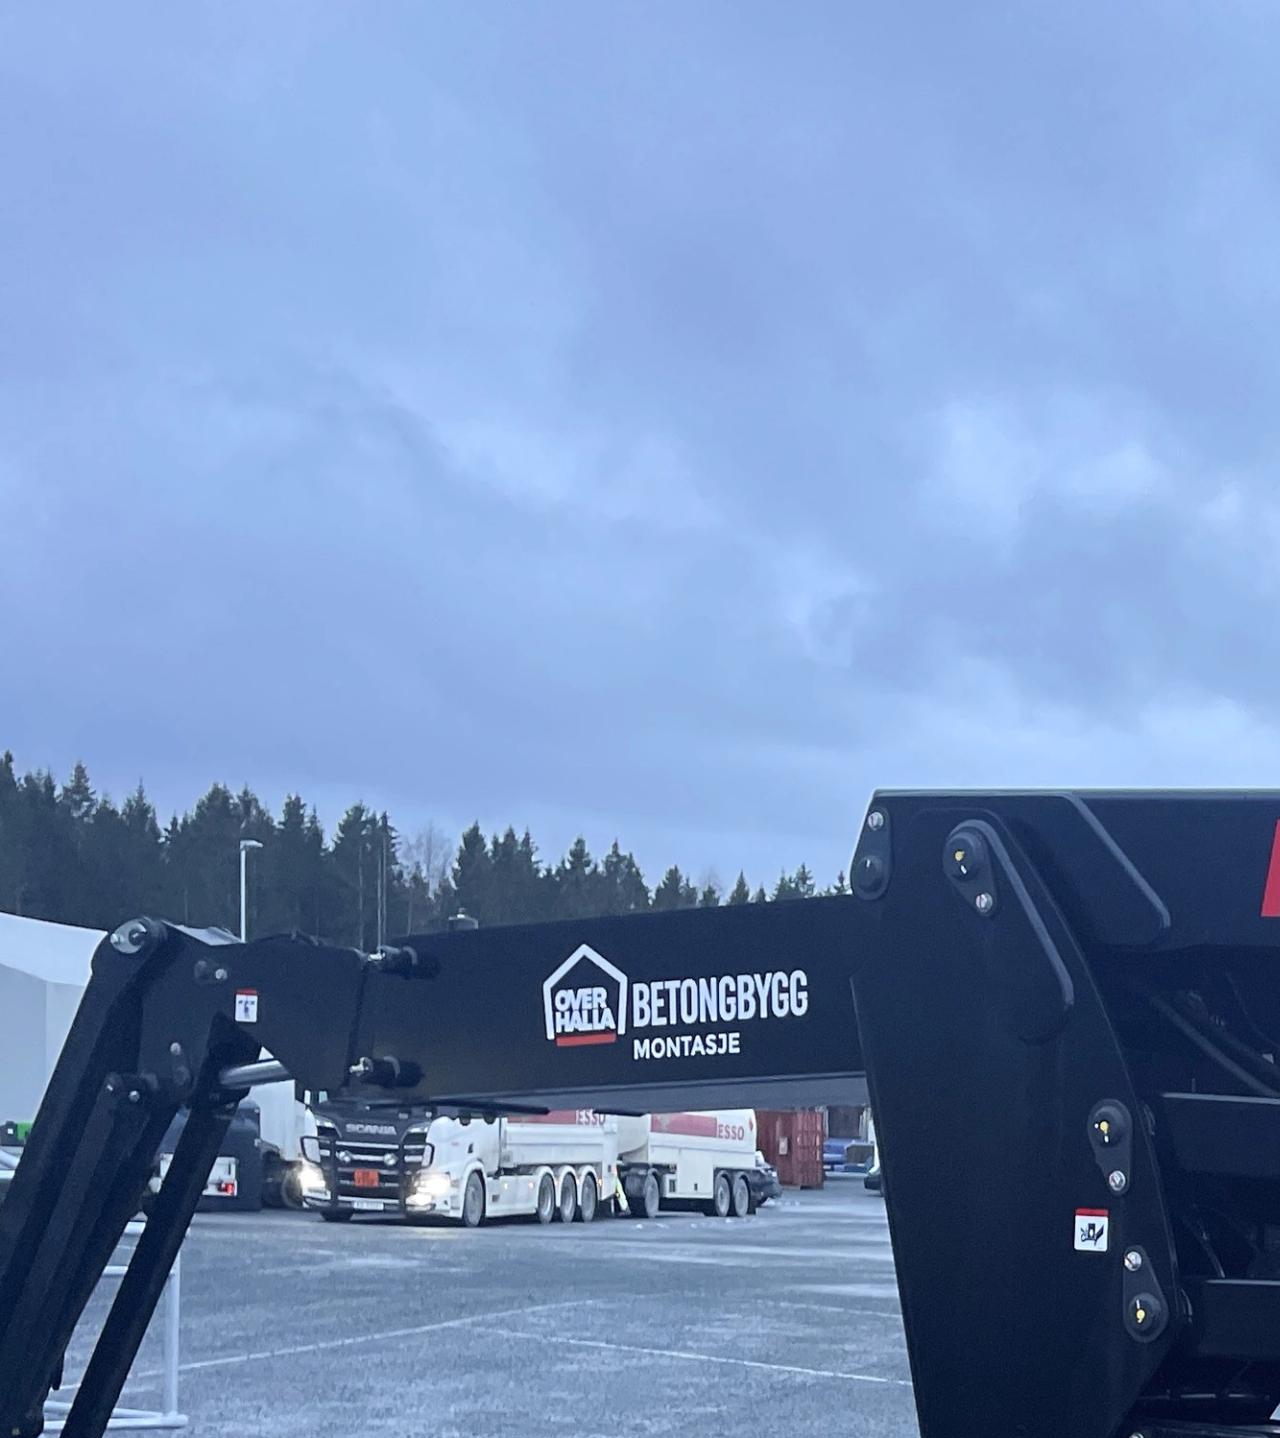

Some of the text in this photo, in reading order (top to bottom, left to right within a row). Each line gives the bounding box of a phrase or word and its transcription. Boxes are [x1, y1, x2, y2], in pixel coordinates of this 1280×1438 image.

[555, 987, 608, 1012] OVER
[632, 970, 809, 1027] BETONGBYGG
[555, 1008, 617, 1033] HALLA
[633, 1032, 741, 1060] MONTASJE
[345, 1123, 398, 1136] SCANIA
[718, 1124, 745, 1141] ESSO
